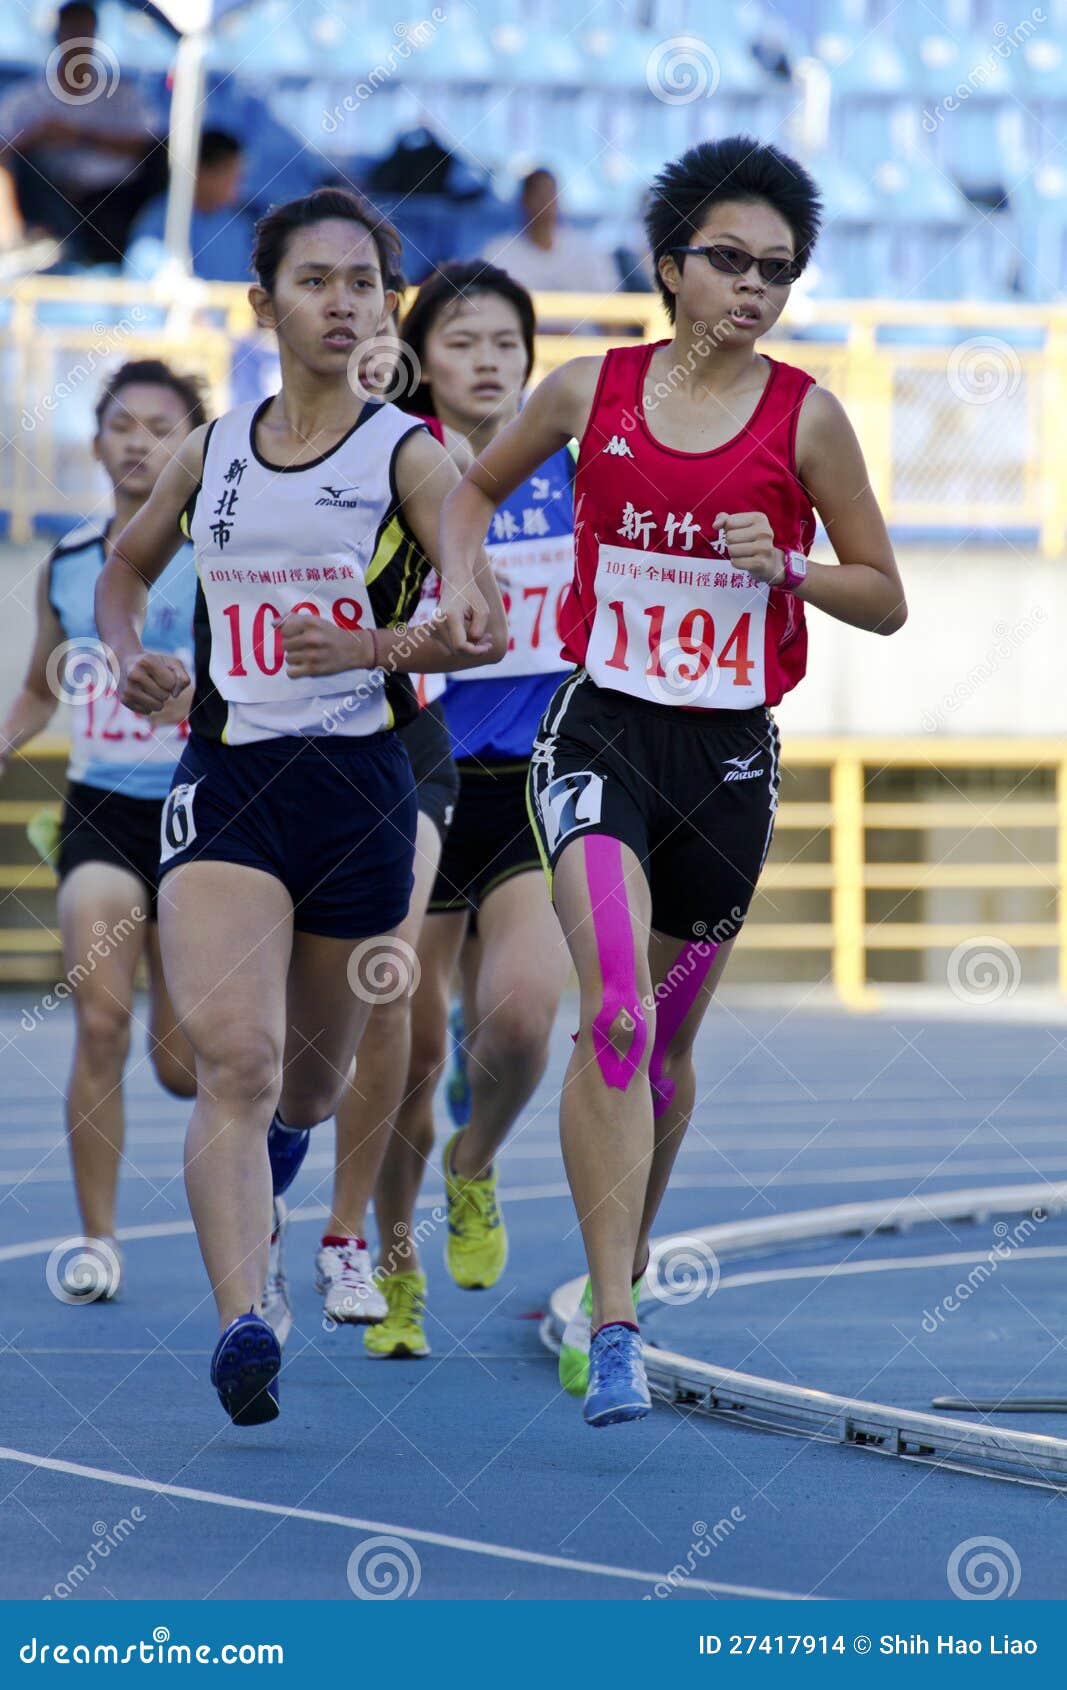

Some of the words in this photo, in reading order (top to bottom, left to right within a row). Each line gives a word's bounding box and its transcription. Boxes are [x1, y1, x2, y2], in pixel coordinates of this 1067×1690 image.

[210, 458, 247, 550] 新北市
[223, 597, 363, 676] 108
[605, 600, 755, 686] 1194
[165, 794, 189, 850] 6
